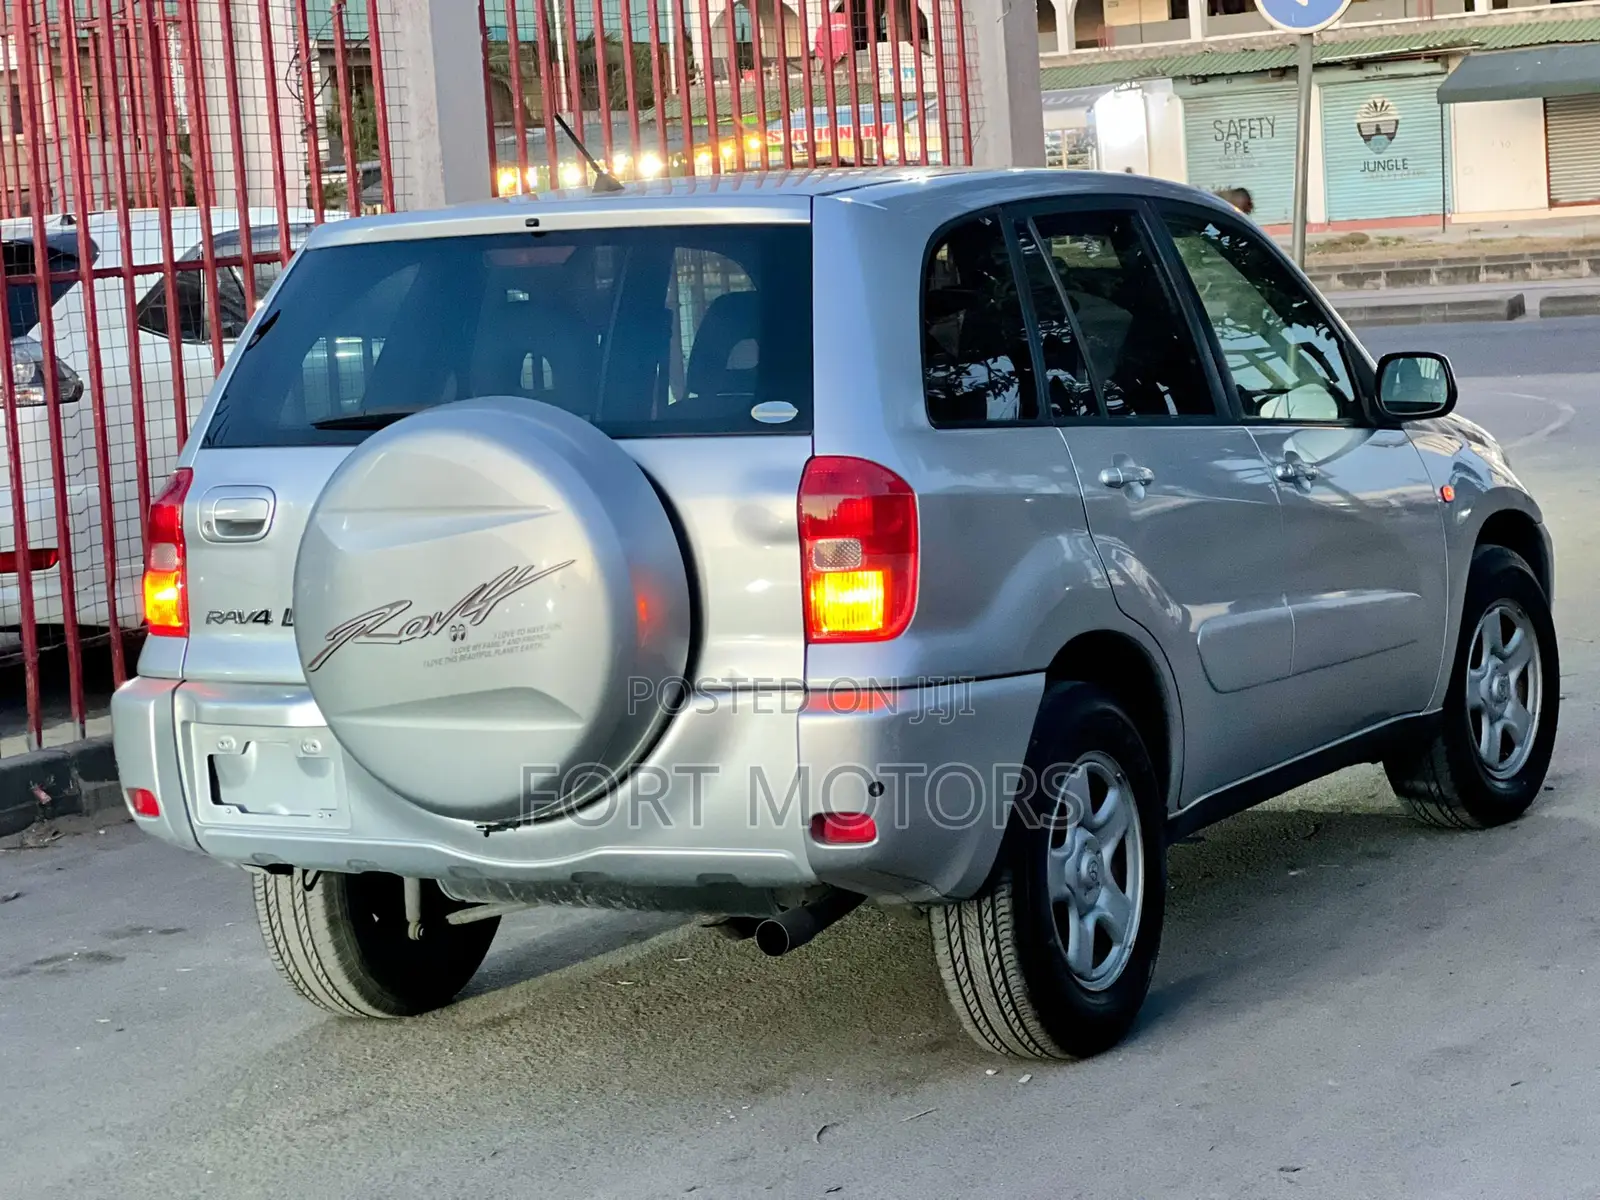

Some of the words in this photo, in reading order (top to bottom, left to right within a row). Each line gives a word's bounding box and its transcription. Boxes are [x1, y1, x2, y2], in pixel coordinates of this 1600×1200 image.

[1213, 115, 1276, 141] SAFETY
[1224, 140, 1250, 155] PPE
[1360, 158, 1408, 172] JUNGLE
[205, 608, 273, 625] RAV4
[498, 629, 515, 639] LOVE
[454, 645, 471, 654] LOVE
[482, 638, 506, 649] FAMILY
[427, 657, 444, 667] LOVE
[494, 645, 520, 657] PLANET
